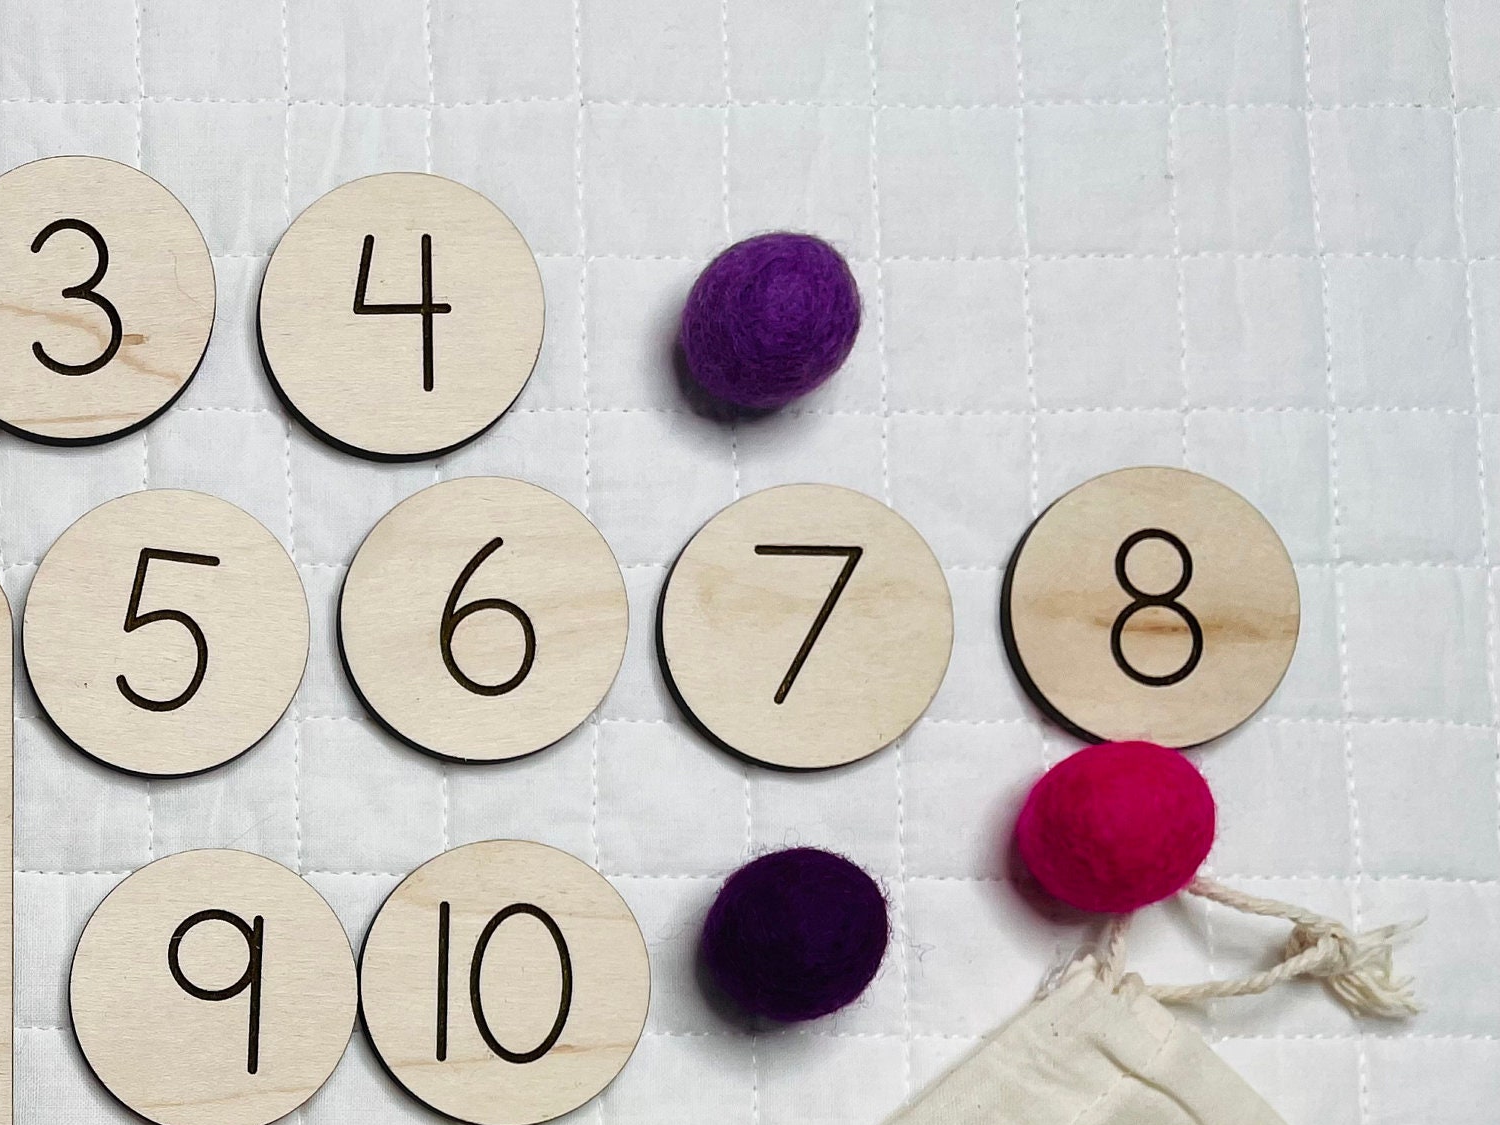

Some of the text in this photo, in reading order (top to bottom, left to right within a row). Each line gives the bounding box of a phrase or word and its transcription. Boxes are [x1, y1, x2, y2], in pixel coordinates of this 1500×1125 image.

[30, 218, 123, 377] 3
[352, 233, 452, 392] 4
[115, 547, 221, 713] 5
[439, 536, 537, 697] 6
[754, 544, 864, 705] 7
[1110, 528, 1204, 687] 8
[167, 908, 265, 1075] 9
[436, 901, 573, 1065] 10
